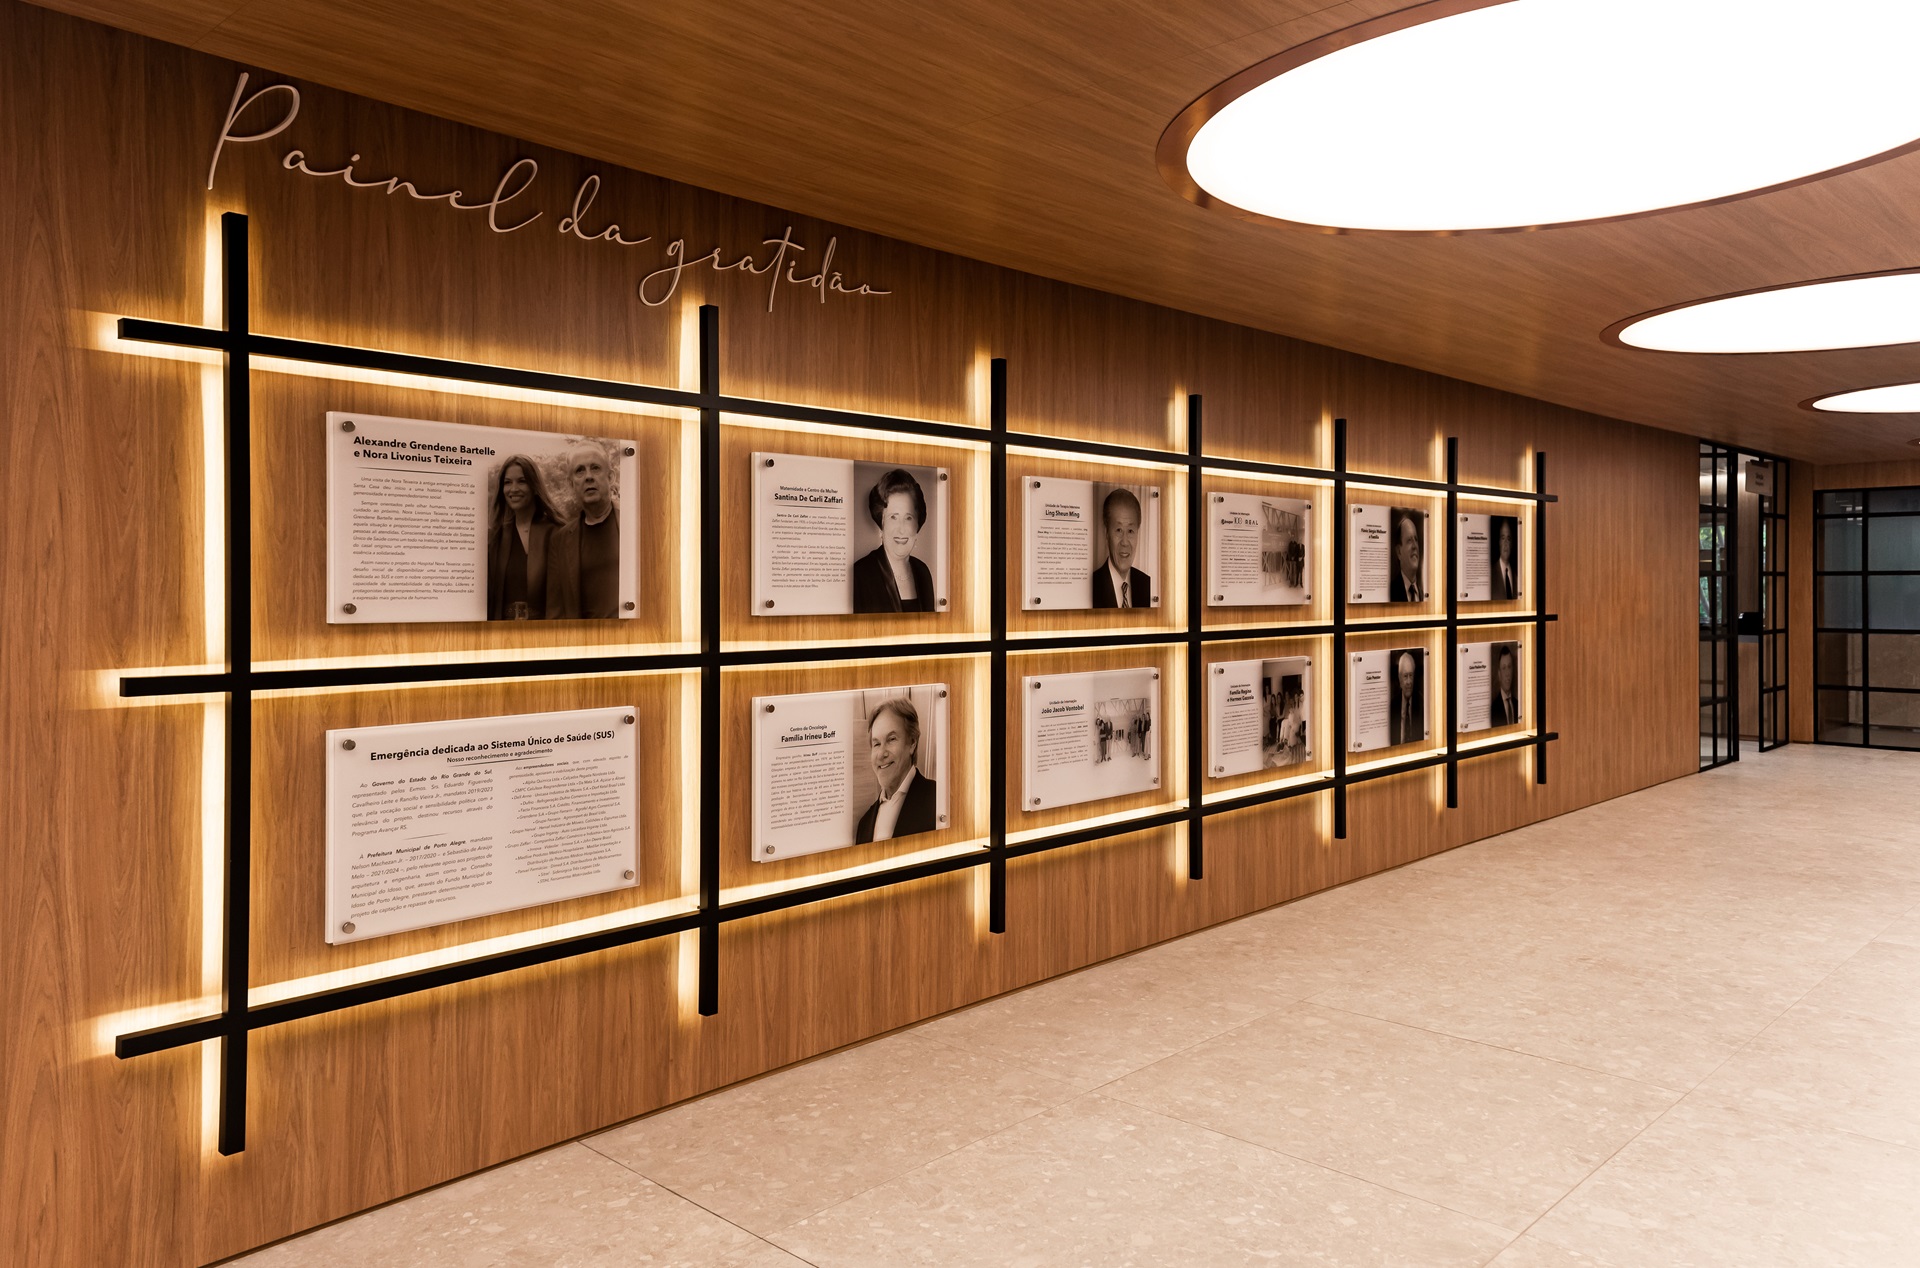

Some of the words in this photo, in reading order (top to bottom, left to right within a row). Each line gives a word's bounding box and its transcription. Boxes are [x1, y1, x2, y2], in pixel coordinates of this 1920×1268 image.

[208, 72, 543, 233] Painel
[558, 174, 651, 246] da
[638, 226, 892, 313] gratidão
[353, 436, 407, 448] Alexandre
[409, 441, 457, 453] Grendene
[460, 445, 495, 456] Bartelle
[363, 449, 388, 459] Nora
[391, 452, 431, 463] Livonius
[434, 455, 472, 465] Teixeira
[775, 493, 798, 501] Santina
[781, 734, 803, 742] Família
[823, 731, 835, 739] Boff
[371, 748, 429, 761] Emergência
[432, 743, 475, 755] dedicada
[491, 741, 525, 749] Sistema
[528, 736, 552, 746] Único
[554, 735, 564, 743] de
[567, 733, 592, 742] Saúde
[593, 731, 614, 740] (SUS)
[466, 753, 509, 761] reconhecimento
[514, 748, 553, 757] agradecimento
